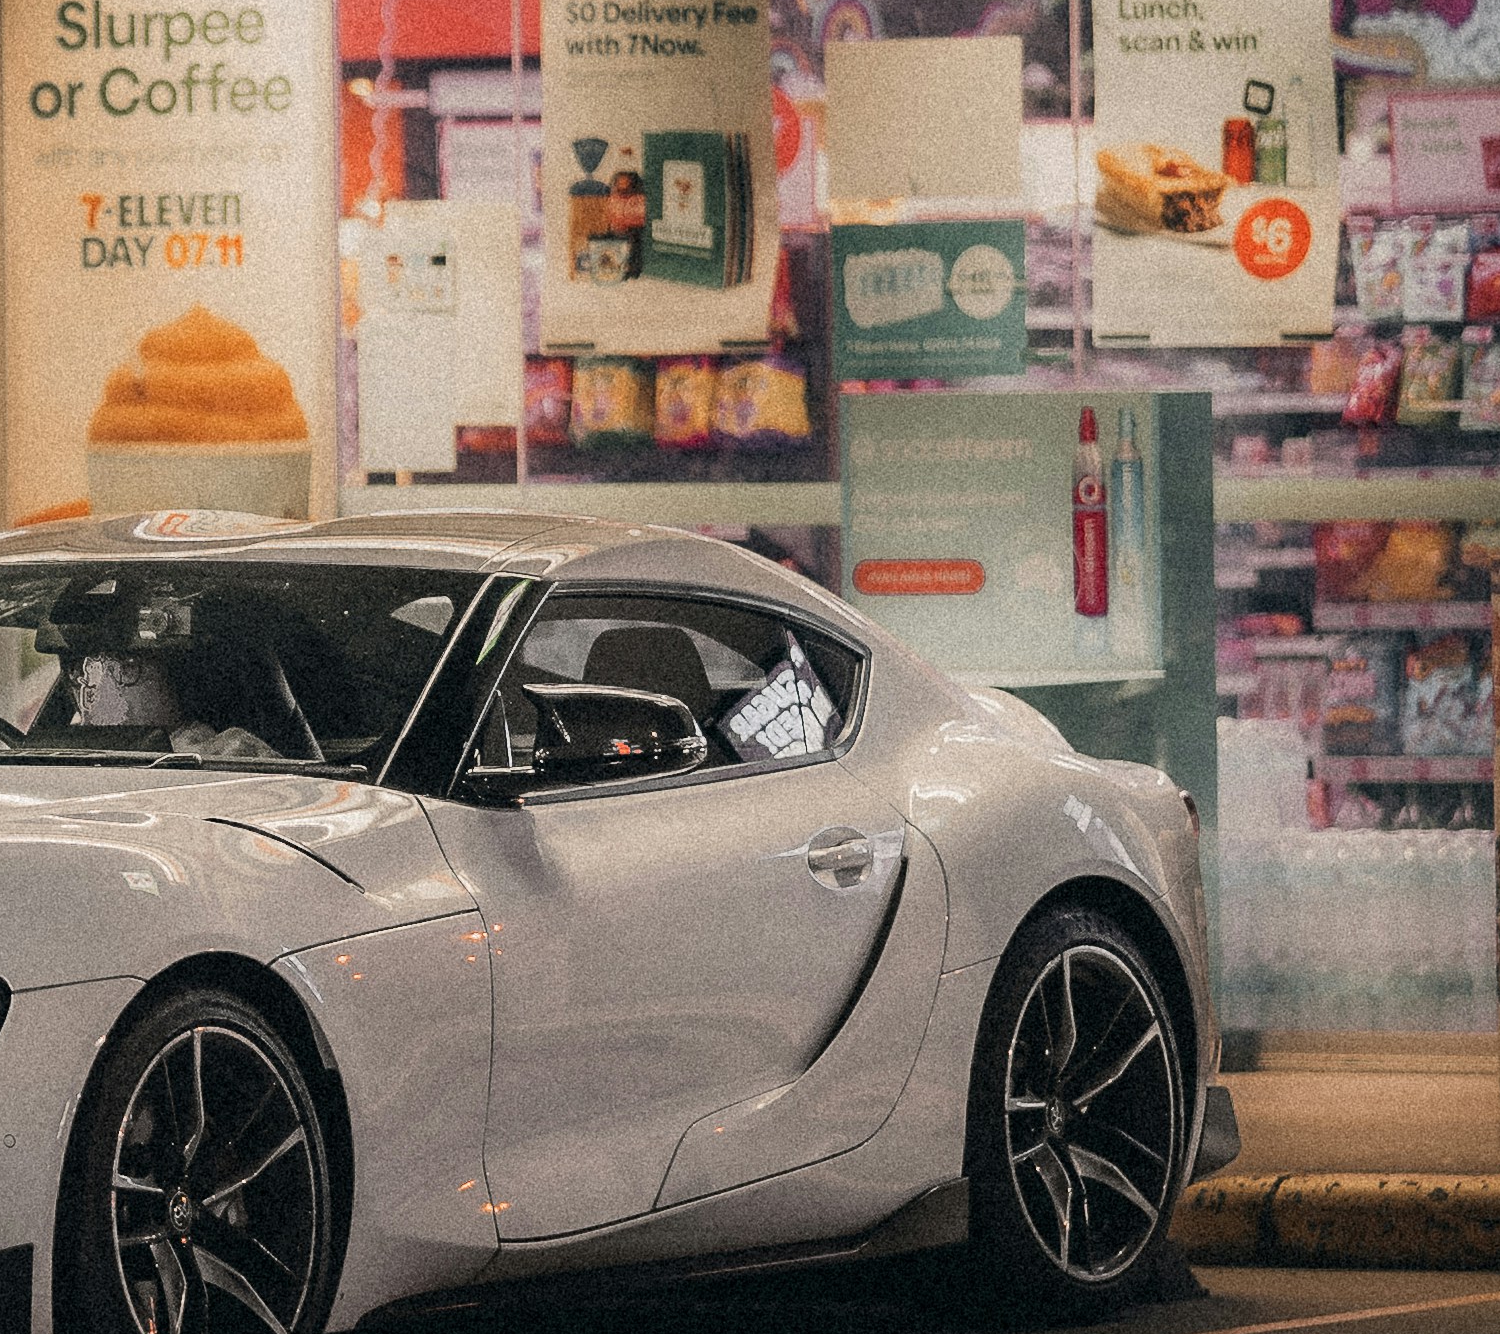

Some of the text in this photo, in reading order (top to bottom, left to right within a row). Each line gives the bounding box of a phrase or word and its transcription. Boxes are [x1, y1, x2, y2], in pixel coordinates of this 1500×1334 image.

[603, 0, 708, 28] Delivery
[713, 1, 759, 26] Fee
[56, 1, 265, 60] Slurpee
[566, 34, 620, 58] with
[1119, 33, 1181, 53] scan
[1189, 28, 1204, 52] &
[29, 63, 293, 120] or Coffee
[1251, 214, 1293, 253] $6
[81, 237, 155, 269] DAY
